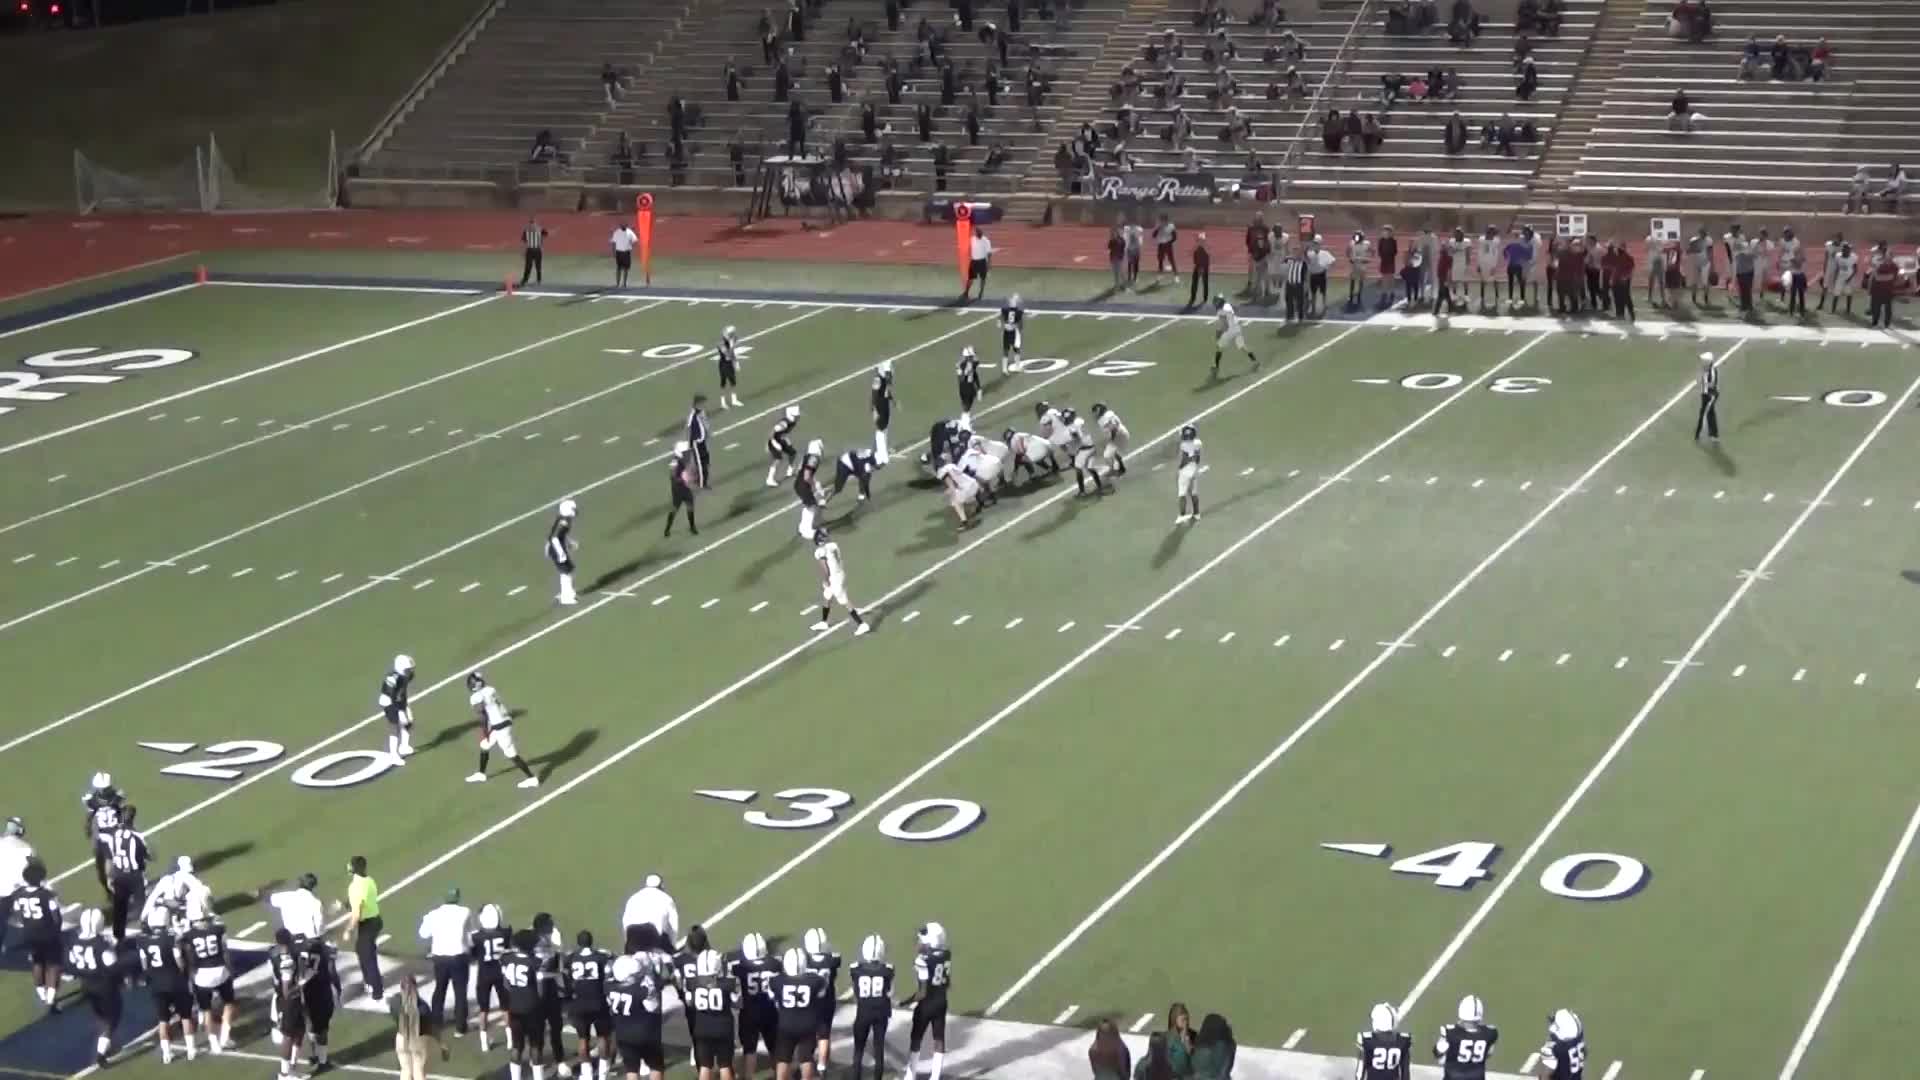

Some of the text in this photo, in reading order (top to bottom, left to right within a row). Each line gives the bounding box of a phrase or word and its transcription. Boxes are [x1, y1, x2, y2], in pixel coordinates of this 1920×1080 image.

[0, 347, 193, 415] RS
[483, 937, 505, 962] 15
[694, 987, 723, 1011] 60
[782, 985, 811, 1008] 53
[858, 976, 884, 998] 88
[1372, 1047, 1401, 1070] 20
[1457, 1039, 1487, 1063] 59
